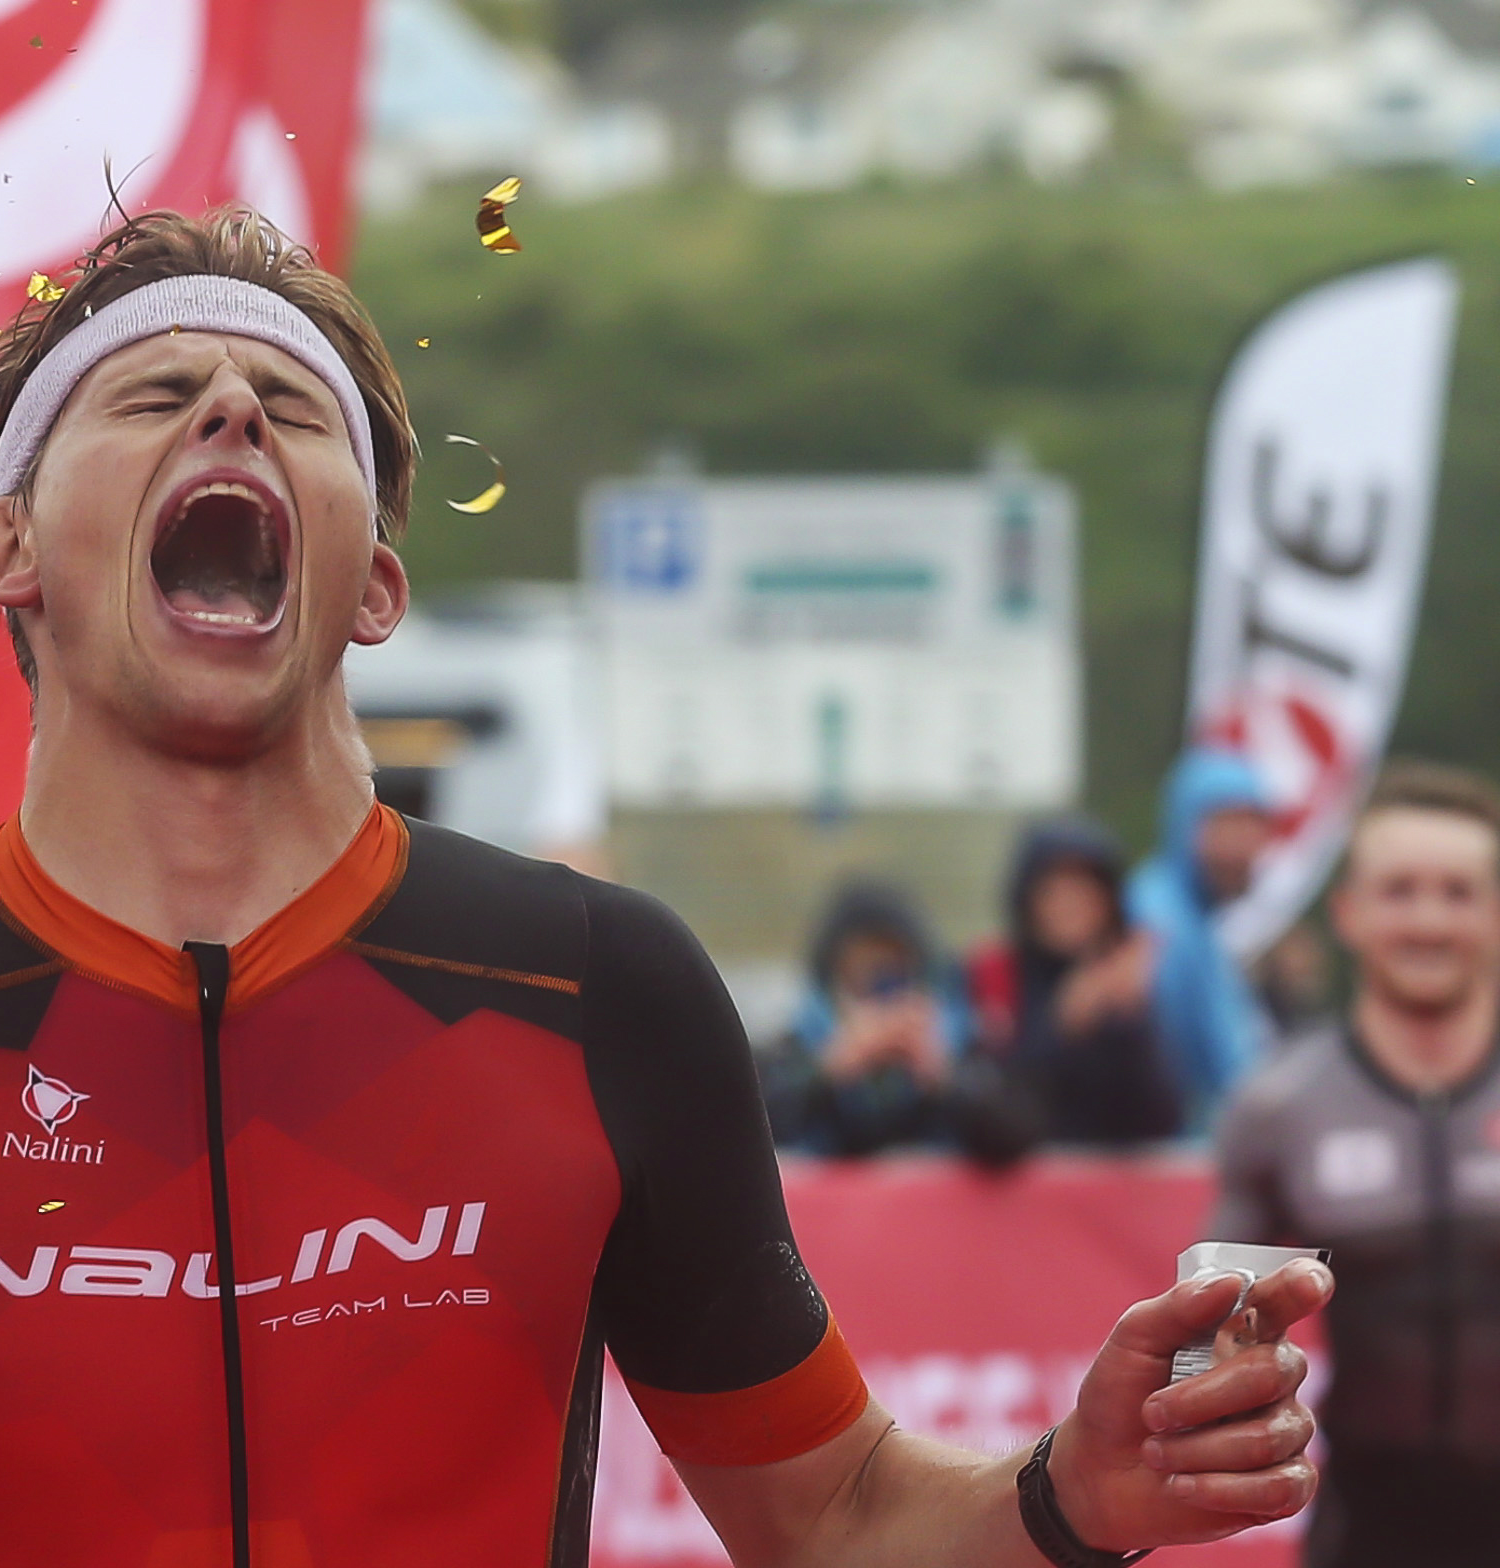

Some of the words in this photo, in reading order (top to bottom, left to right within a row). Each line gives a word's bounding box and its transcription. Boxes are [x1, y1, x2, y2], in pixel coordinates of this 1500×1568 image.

[2, 1132, 106, 1166] Nalini
[259, 1295, 387, 1333] TEAM
[402, 1287, 491, 1308] LAB
